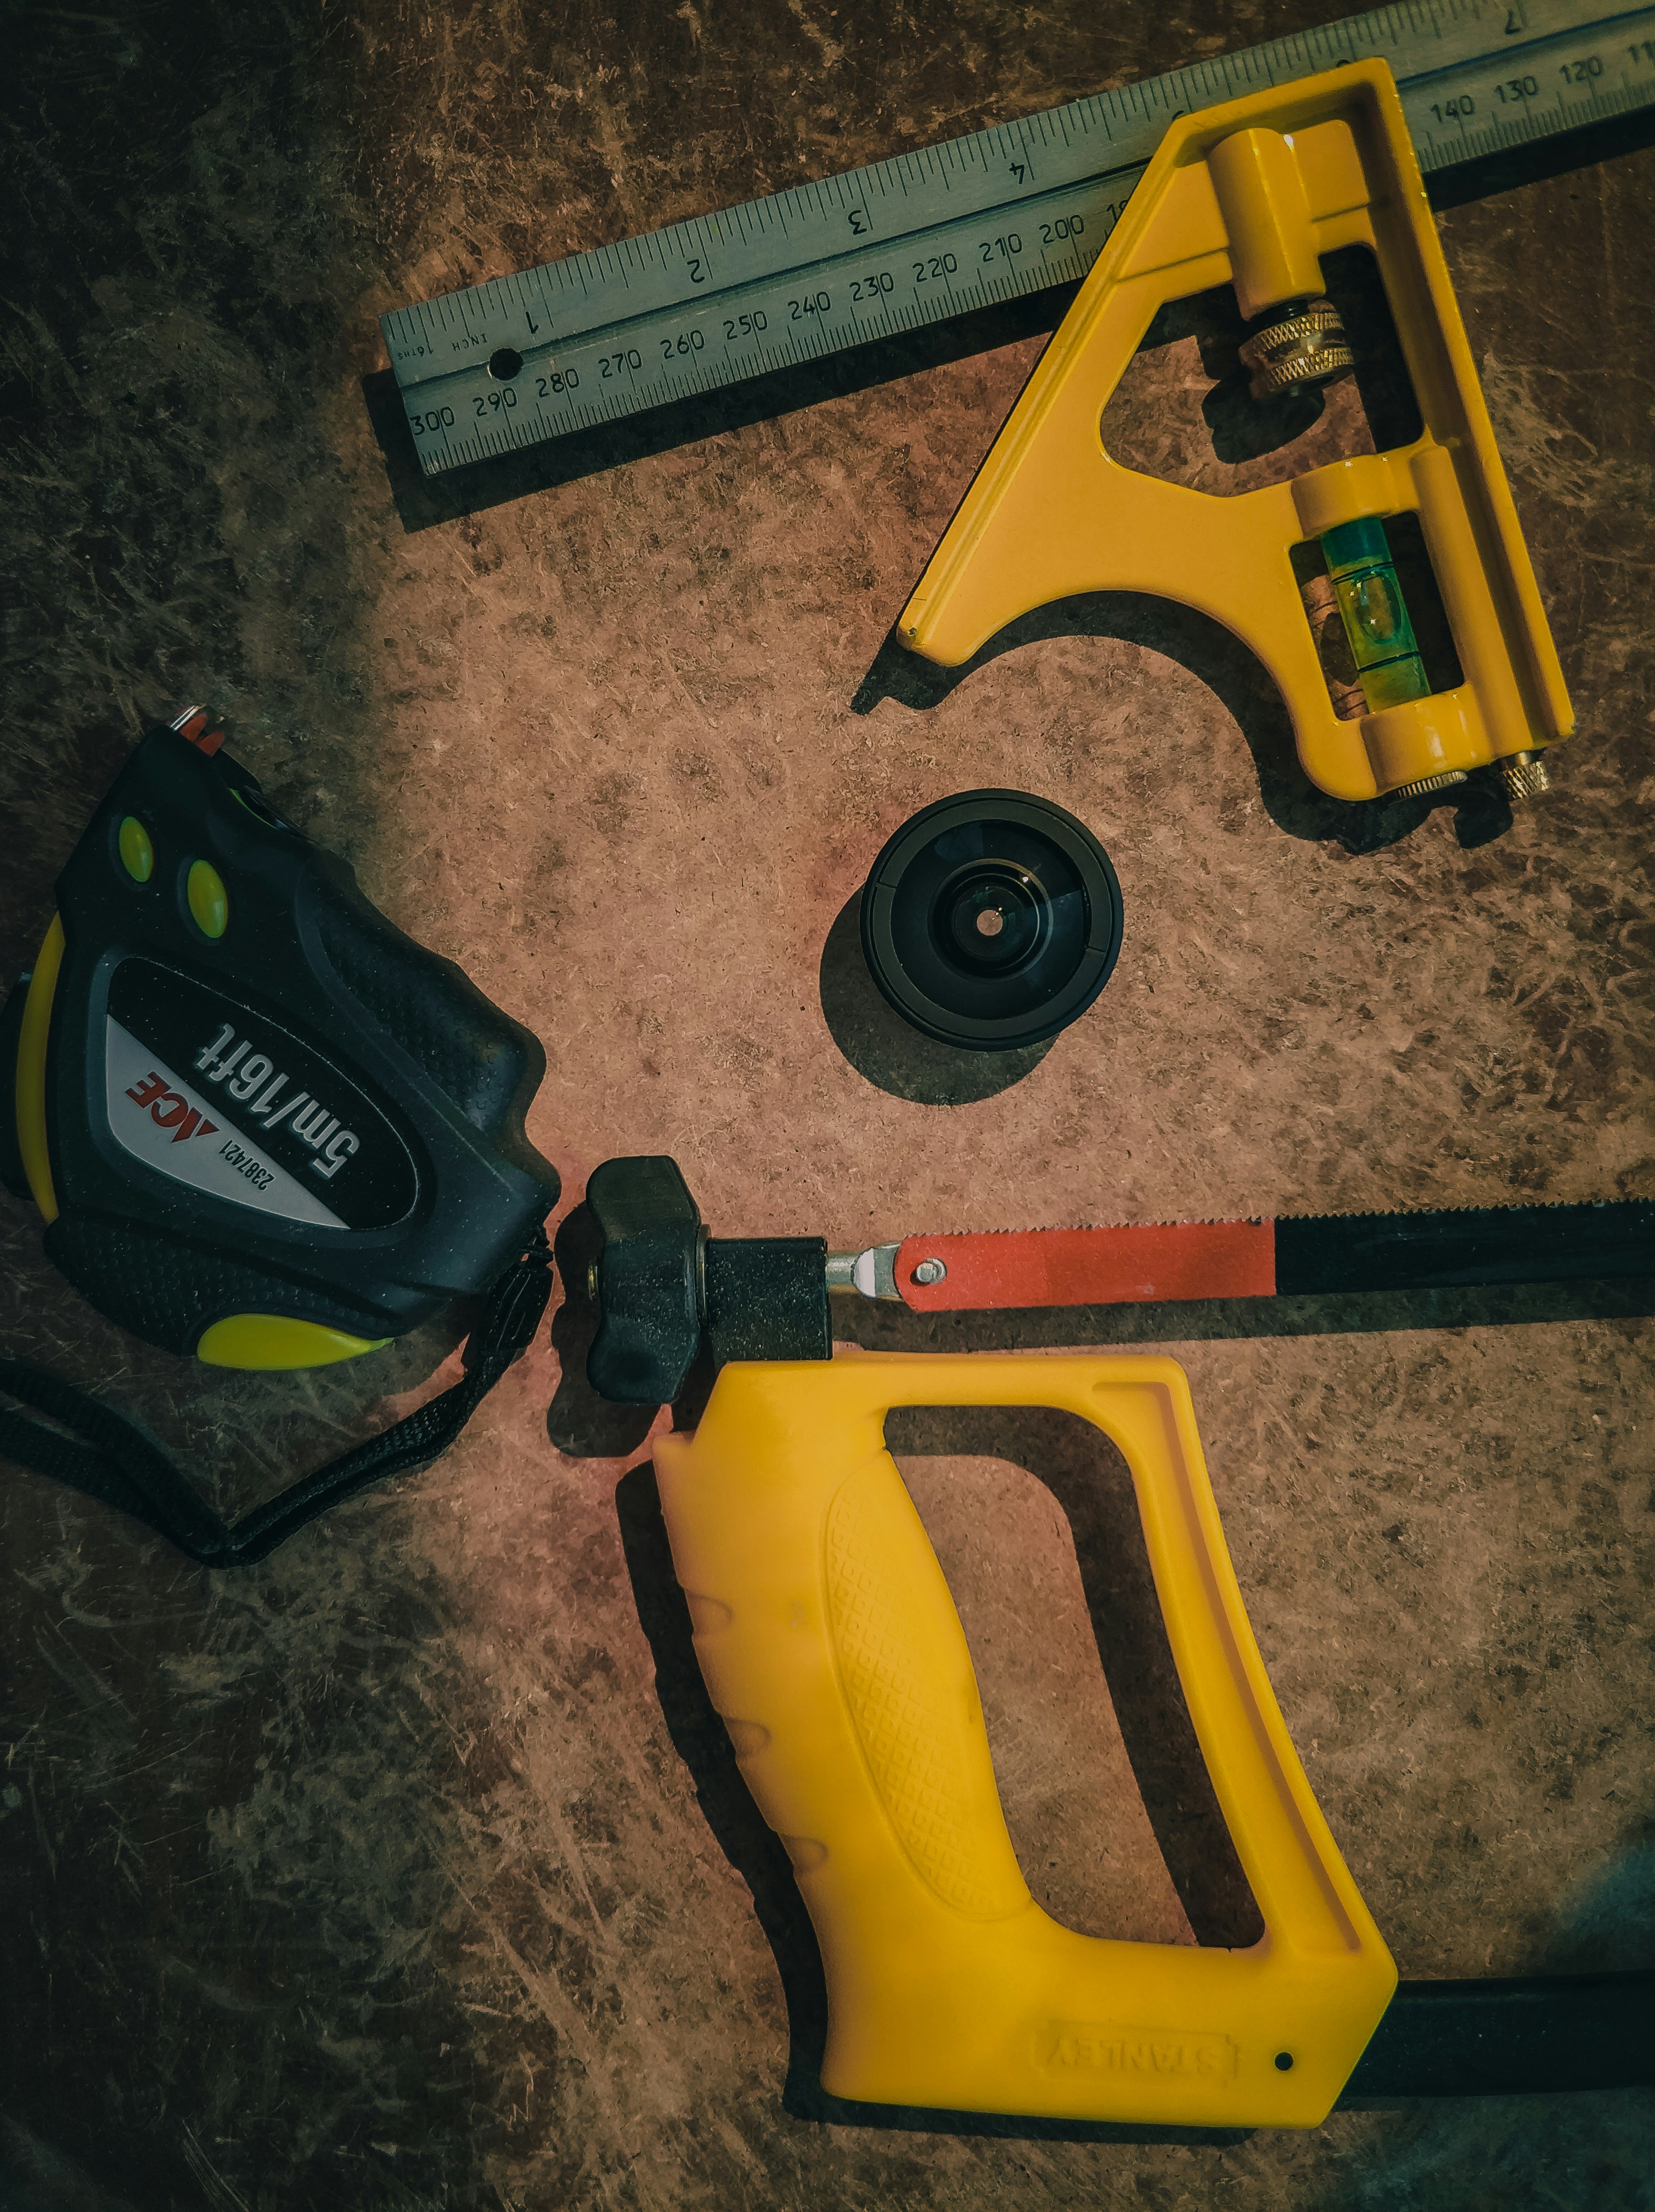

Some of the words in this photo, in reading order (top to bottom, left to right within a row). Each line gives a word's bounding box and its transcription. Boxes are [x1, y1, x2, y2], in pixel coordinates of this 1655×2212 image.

[1009, 162, 1024, 185] 4
[847, 210, 868, 235] 3
[410, 406, 455, 436] 300
[473, 387, 517, 417] 290
[535, 368, 579, 398] 280
[598, 349, 641, 379] 270
[660, 330, 705, 359] 260
[723, 311, 768, 340] 250
[787, 291, 831, 320] 240
[849, 272, 894, 301] 230
[913, 253, 957, 283] 220
[979, 233, 1022, 262] 210
[1039, 215, 1084, 244] 200
[1430, 95, 1475, 123] 140
[1494, 75, 1538, 104] 130
[1560, 55, 1603, 84] 120
[1627, 40, 1655, 64] 11
[687, 258, 705, 284] 2
[525, 311, 539, 334] 1
[451, 332, 488, 353] INCH
[125, 1071, 220, 1143] ACE
[197, 1023, 361, 1178] 5m/16ft
[219, 1139, 275, 1191] 2387421
[1046, 2038, 1219, 2073] STANLEY
